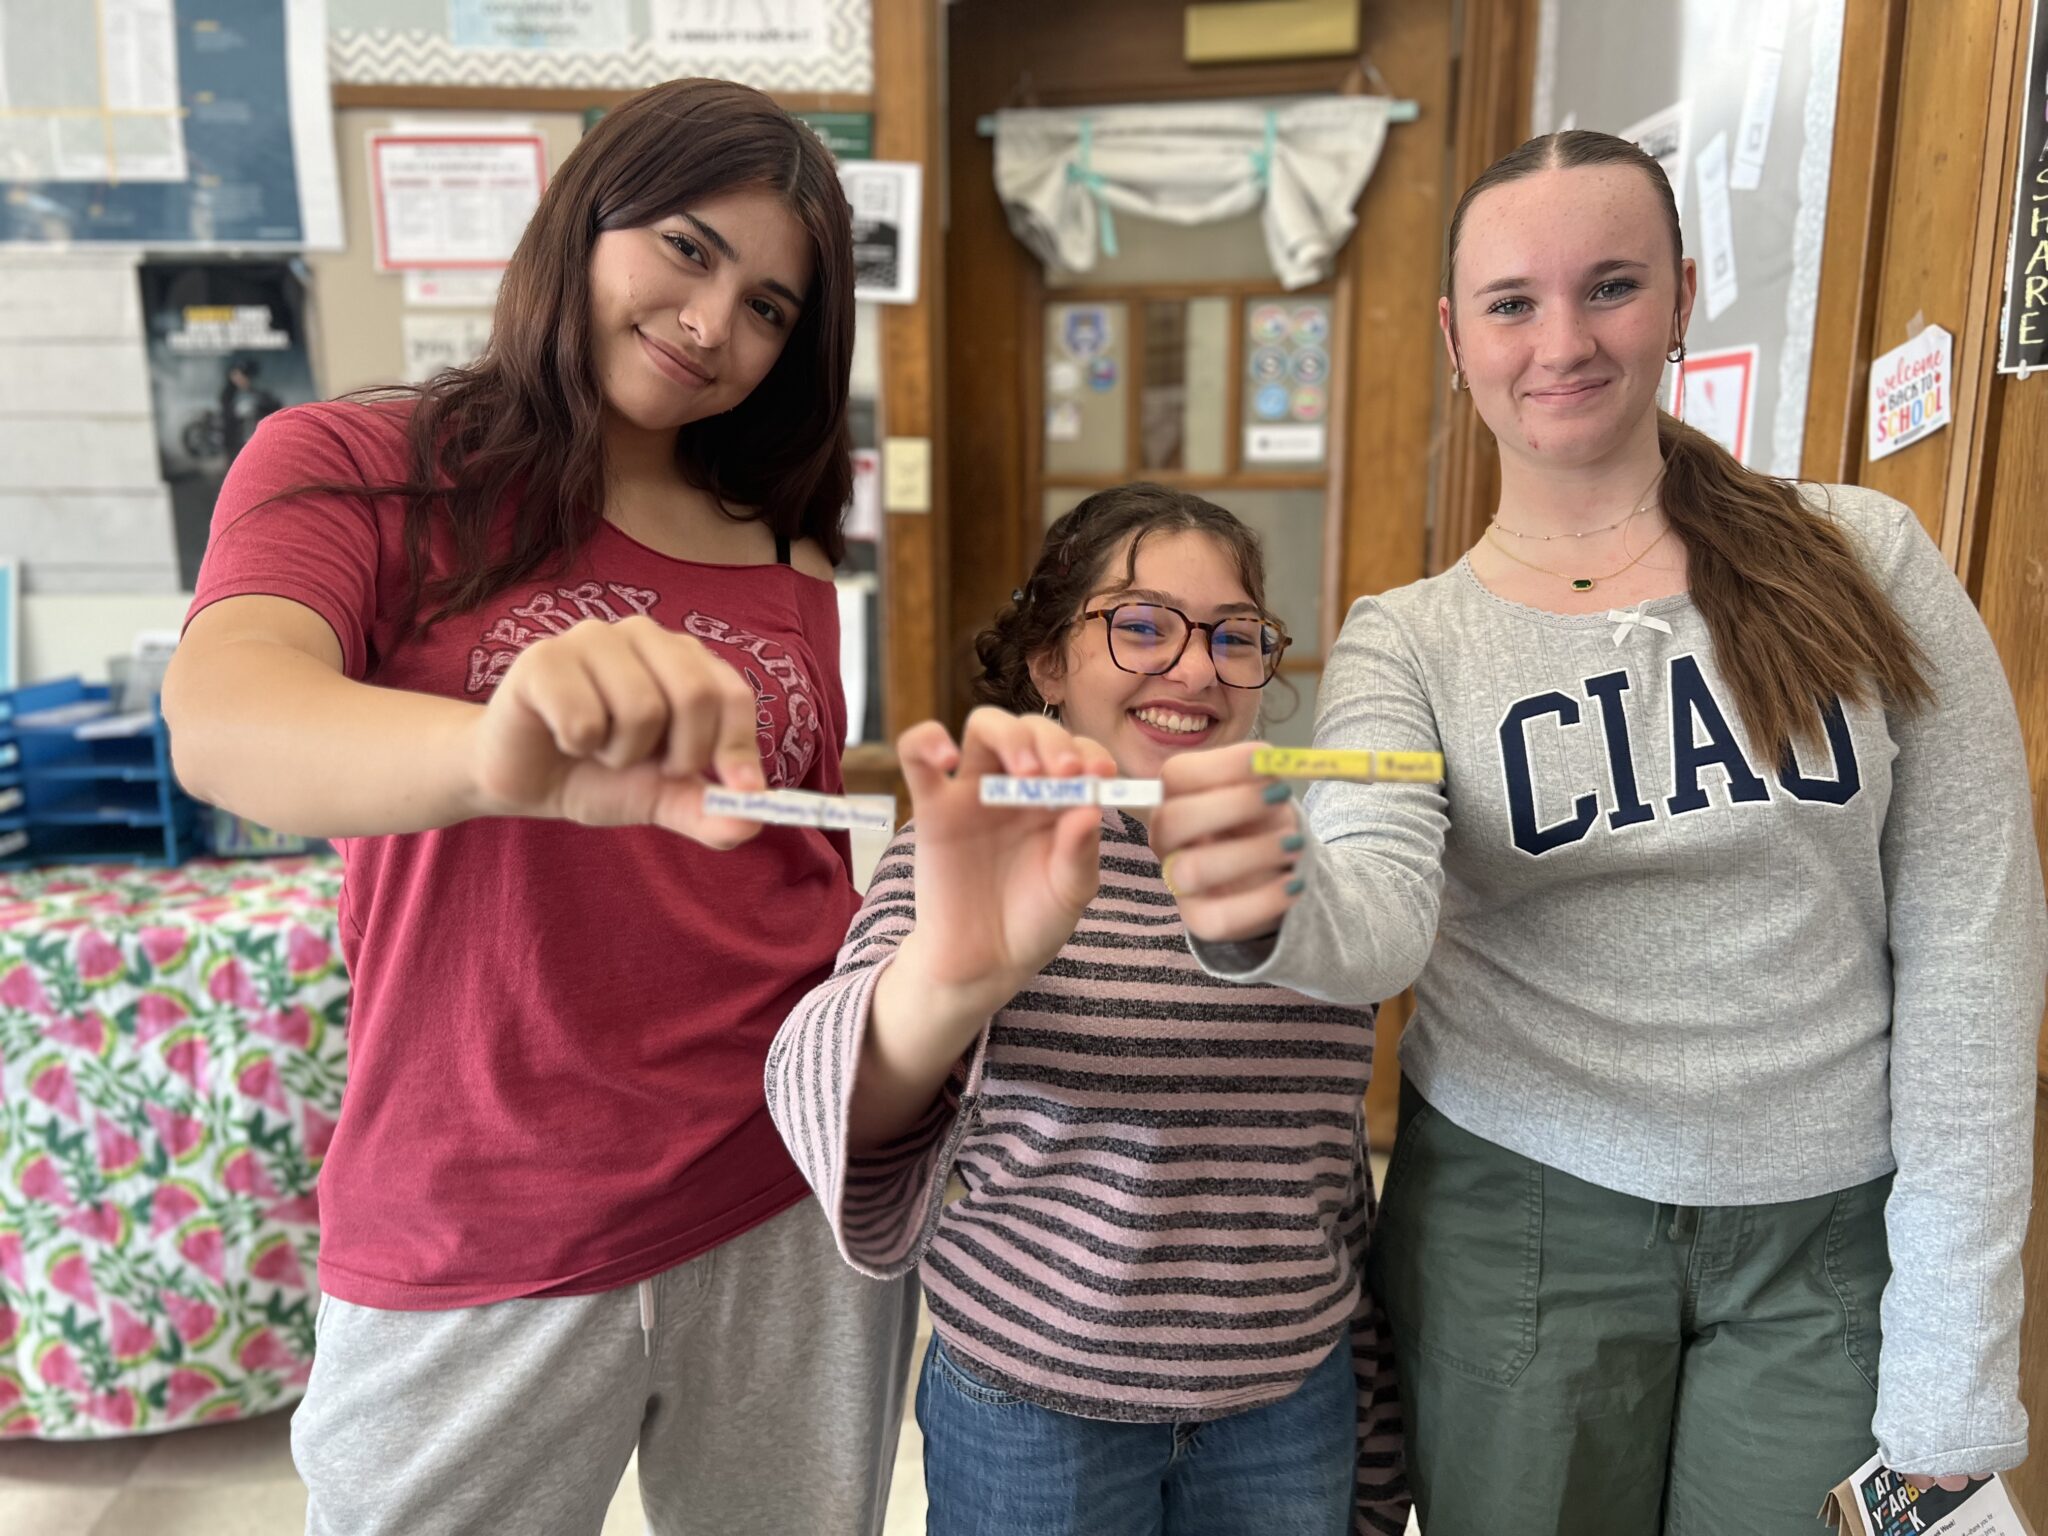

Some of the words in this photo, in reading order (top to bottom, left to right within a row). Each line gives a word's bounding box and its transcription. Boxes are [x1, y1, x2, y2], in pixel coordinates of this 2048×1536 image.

[1876, 349, 1943, 400] welcome
[1888, 381, 1919, 411] BACK
[1920, 372, 1933, 394] TO
[1876, 386, 1943, 443] SCHOOL
[1496, 654, 1862, 857] CIAO
